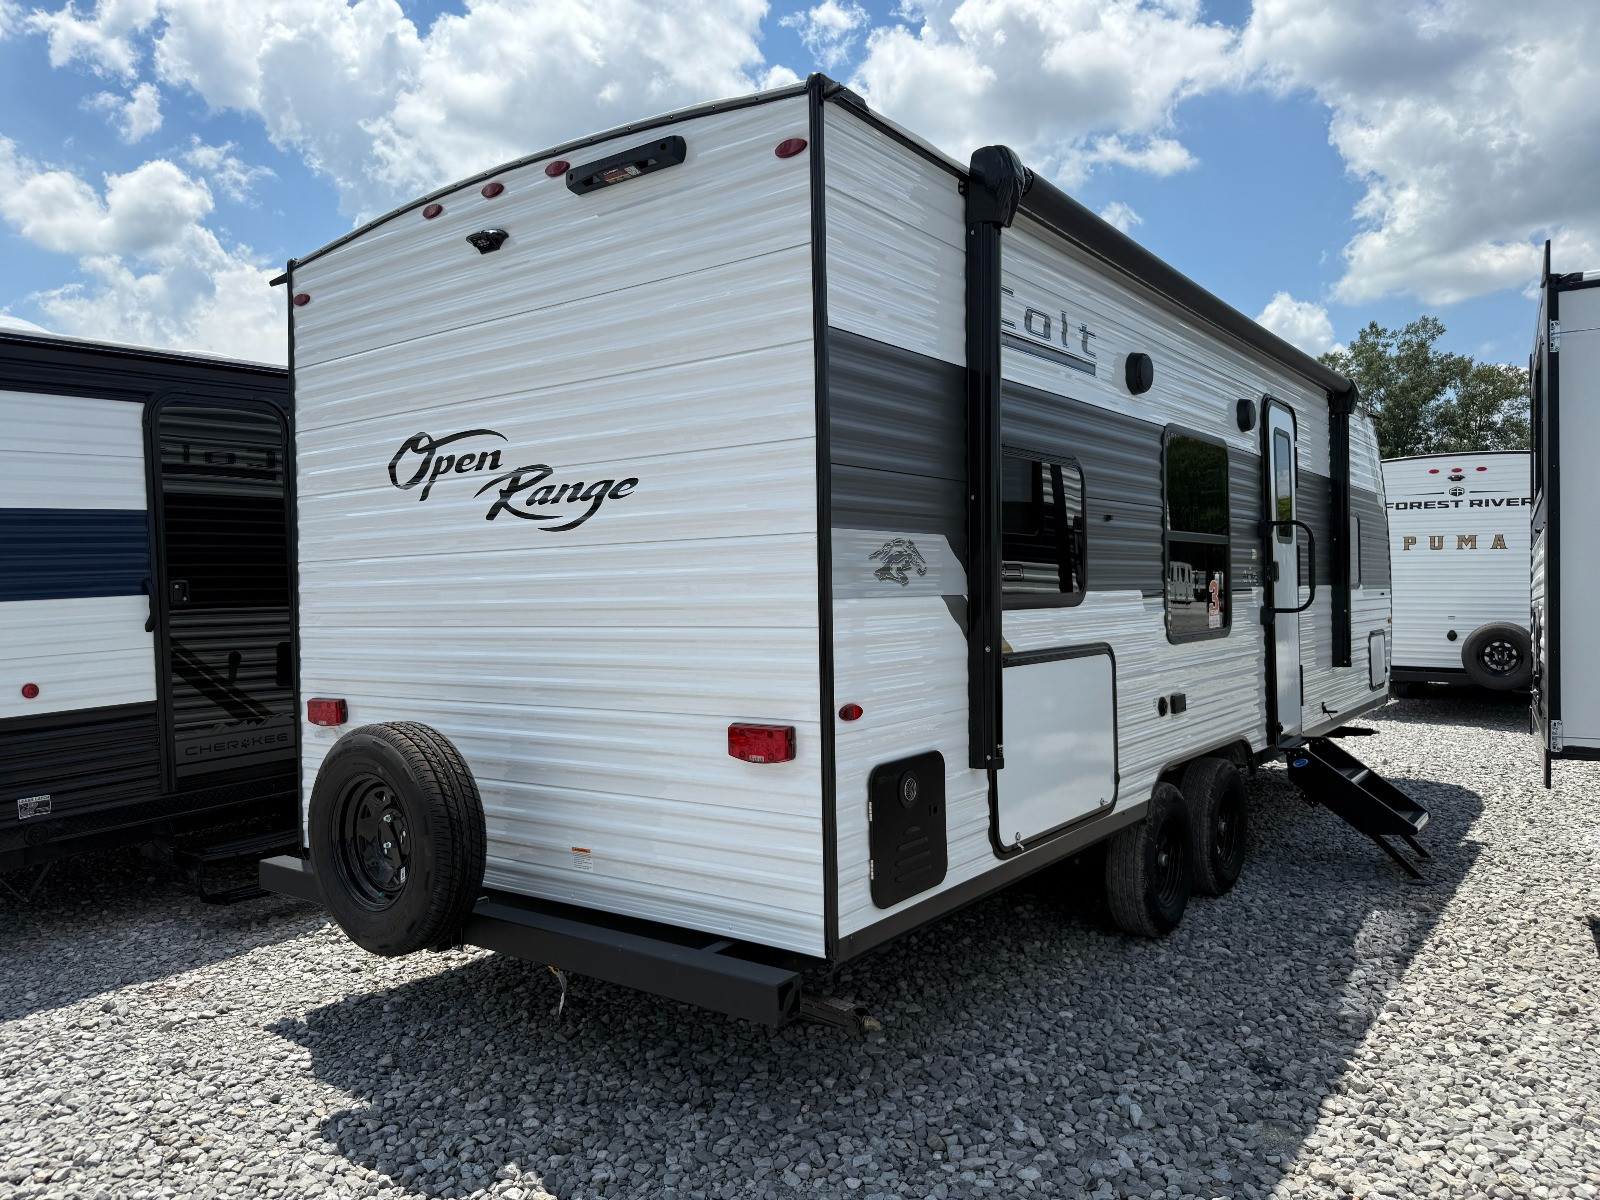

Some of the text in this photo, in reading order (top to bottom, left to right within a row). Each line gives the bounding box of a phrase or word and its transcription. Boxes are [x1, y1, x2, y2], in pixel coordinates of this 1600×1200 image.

[387, 428, 508, 502] Open
[473, 463, 640, 533] Range
[1386, 499, 1464, 511] FOREST
[1402, 533, 1509, 552] PUMA
